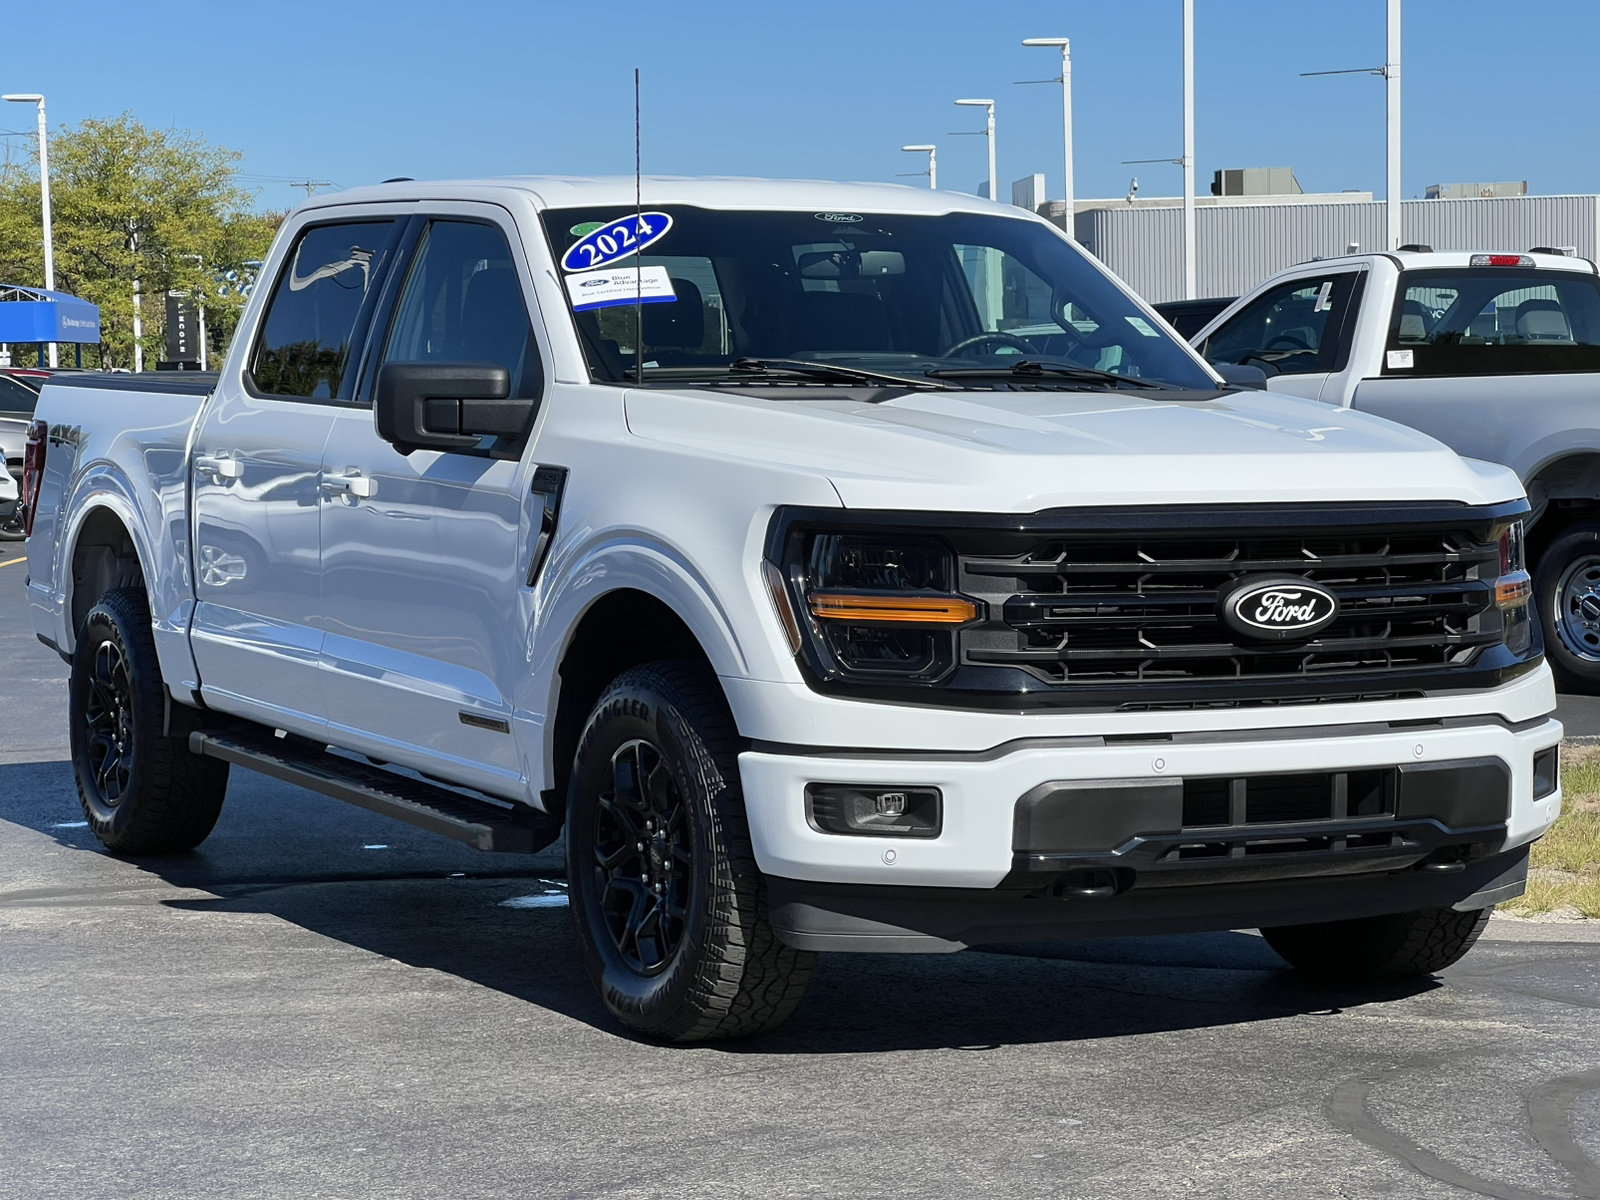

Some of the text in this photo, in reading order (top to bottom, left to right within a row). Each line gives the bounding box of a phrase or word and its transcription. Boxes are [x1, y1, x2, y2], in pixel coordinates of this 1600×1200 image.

[824, 213, 856, 221] Ford
[579, 214, 653, 266] 2024
[177, 303, 186, 353] LINCOLN
[1255, 591, 1317, 622] Ford
